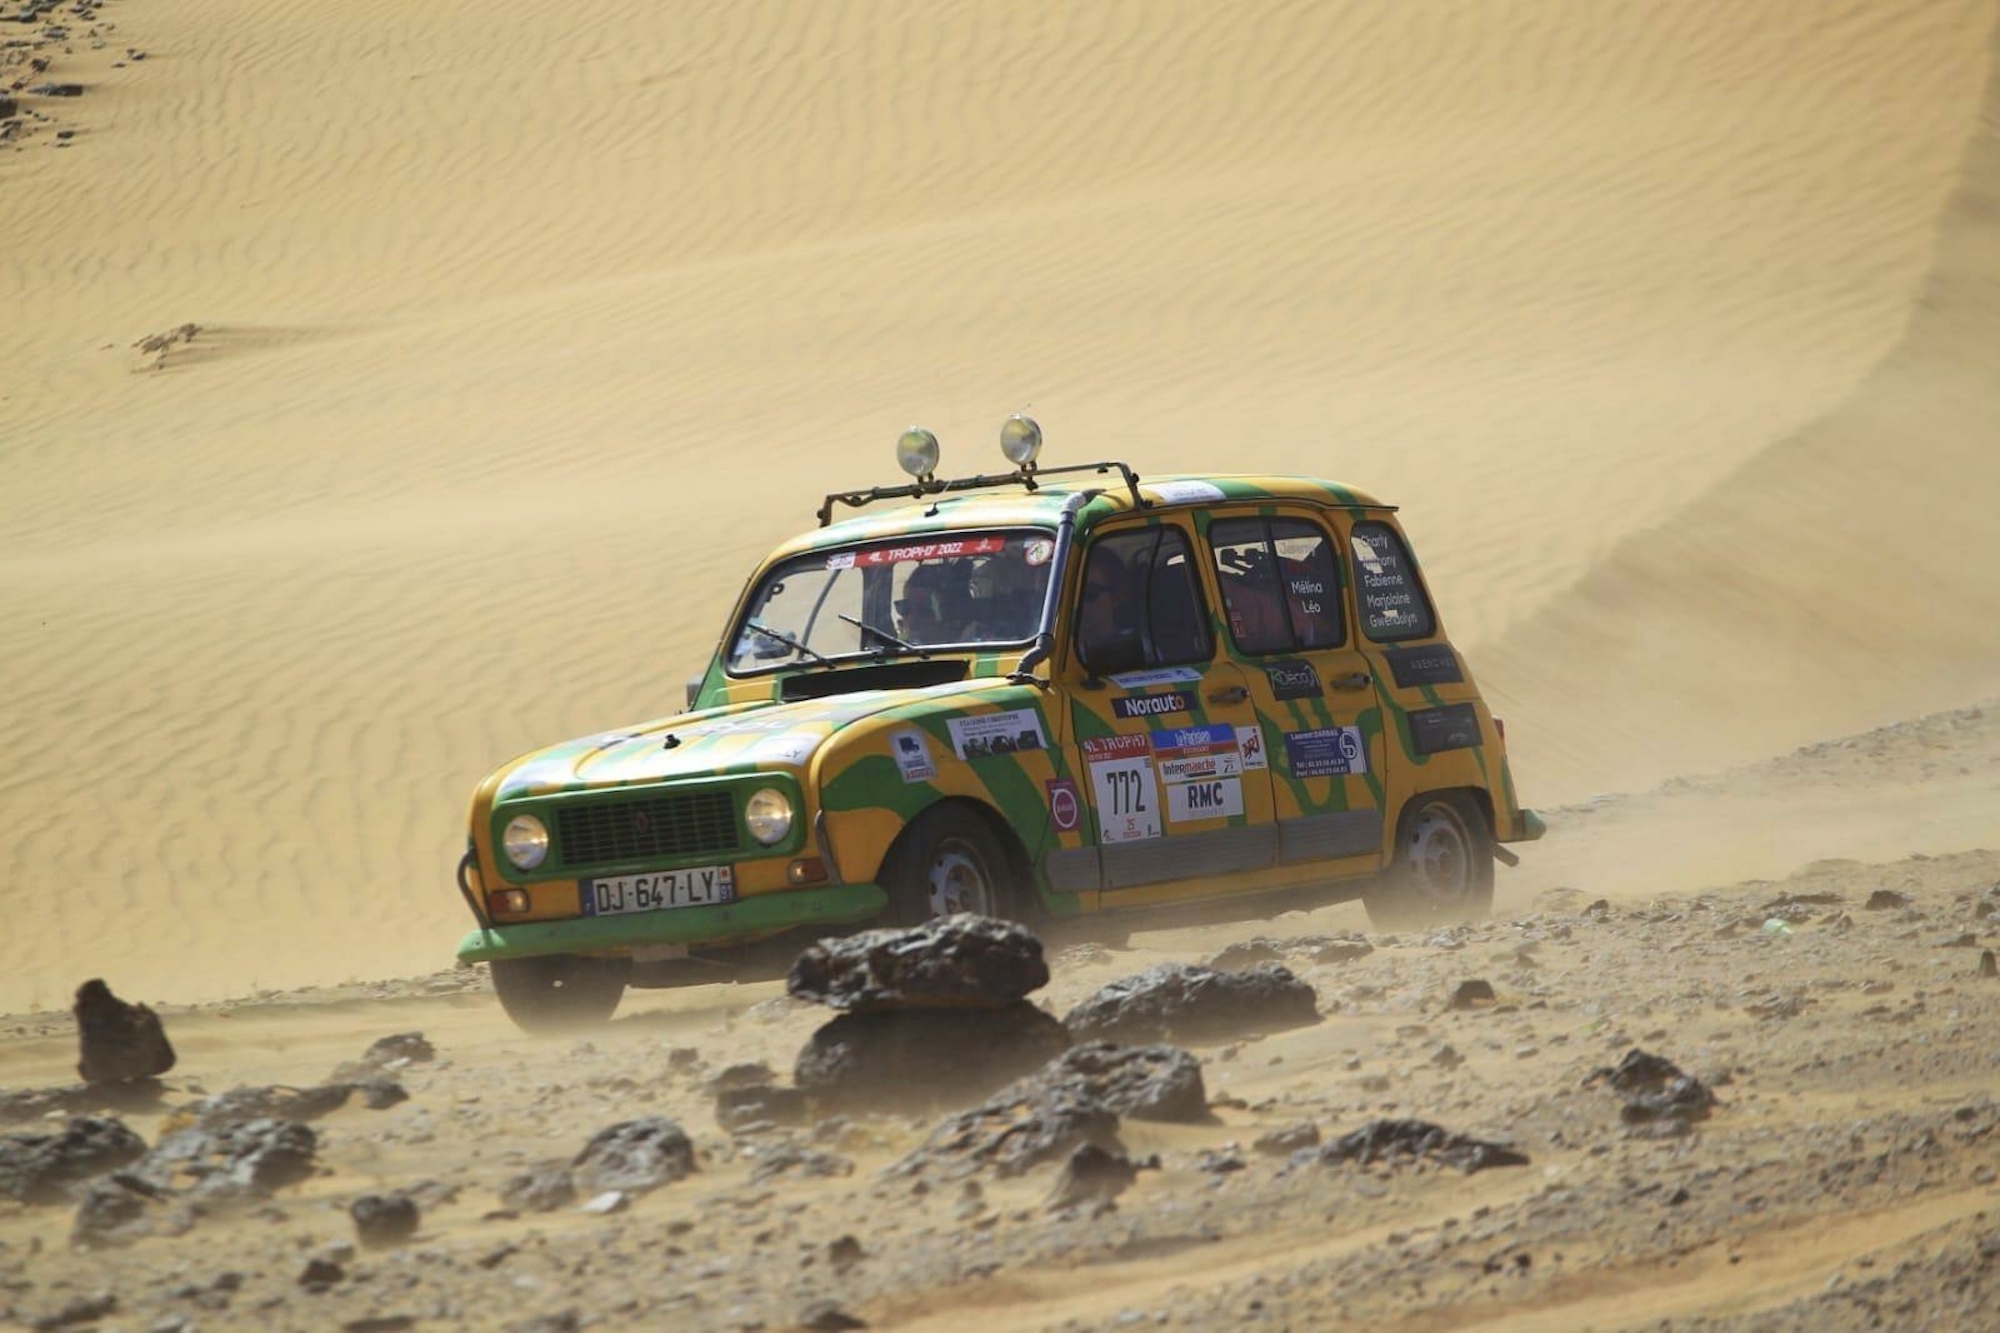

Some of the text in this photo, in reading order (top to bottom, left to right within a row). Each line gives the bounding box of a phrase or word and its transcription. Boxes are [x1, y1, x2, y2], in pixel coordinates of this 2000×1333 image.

[868, 553, 883, 563] 4L
[888, 545, 934, 561] TROPHY
[937, 542, 964, 556] 2022
[1291, 580, 1323, 595] Mélina
[1364, 574, 1404, 587] Fabienne
[1301, 599, 1321, 614] Léo
[1366, 592, 1411, 610] Marjolaine
[1369, 611, 1418, 628] Gwendolyn
[1125, 694, 1185, 716] Norauto
[1100, 735, 1146, 752] TROPHY
[1106, 770, 1146, 815] 772
[1187, 782, 1224, 809] RMC
[596, 871, 714, 912] DJ-647-LY
